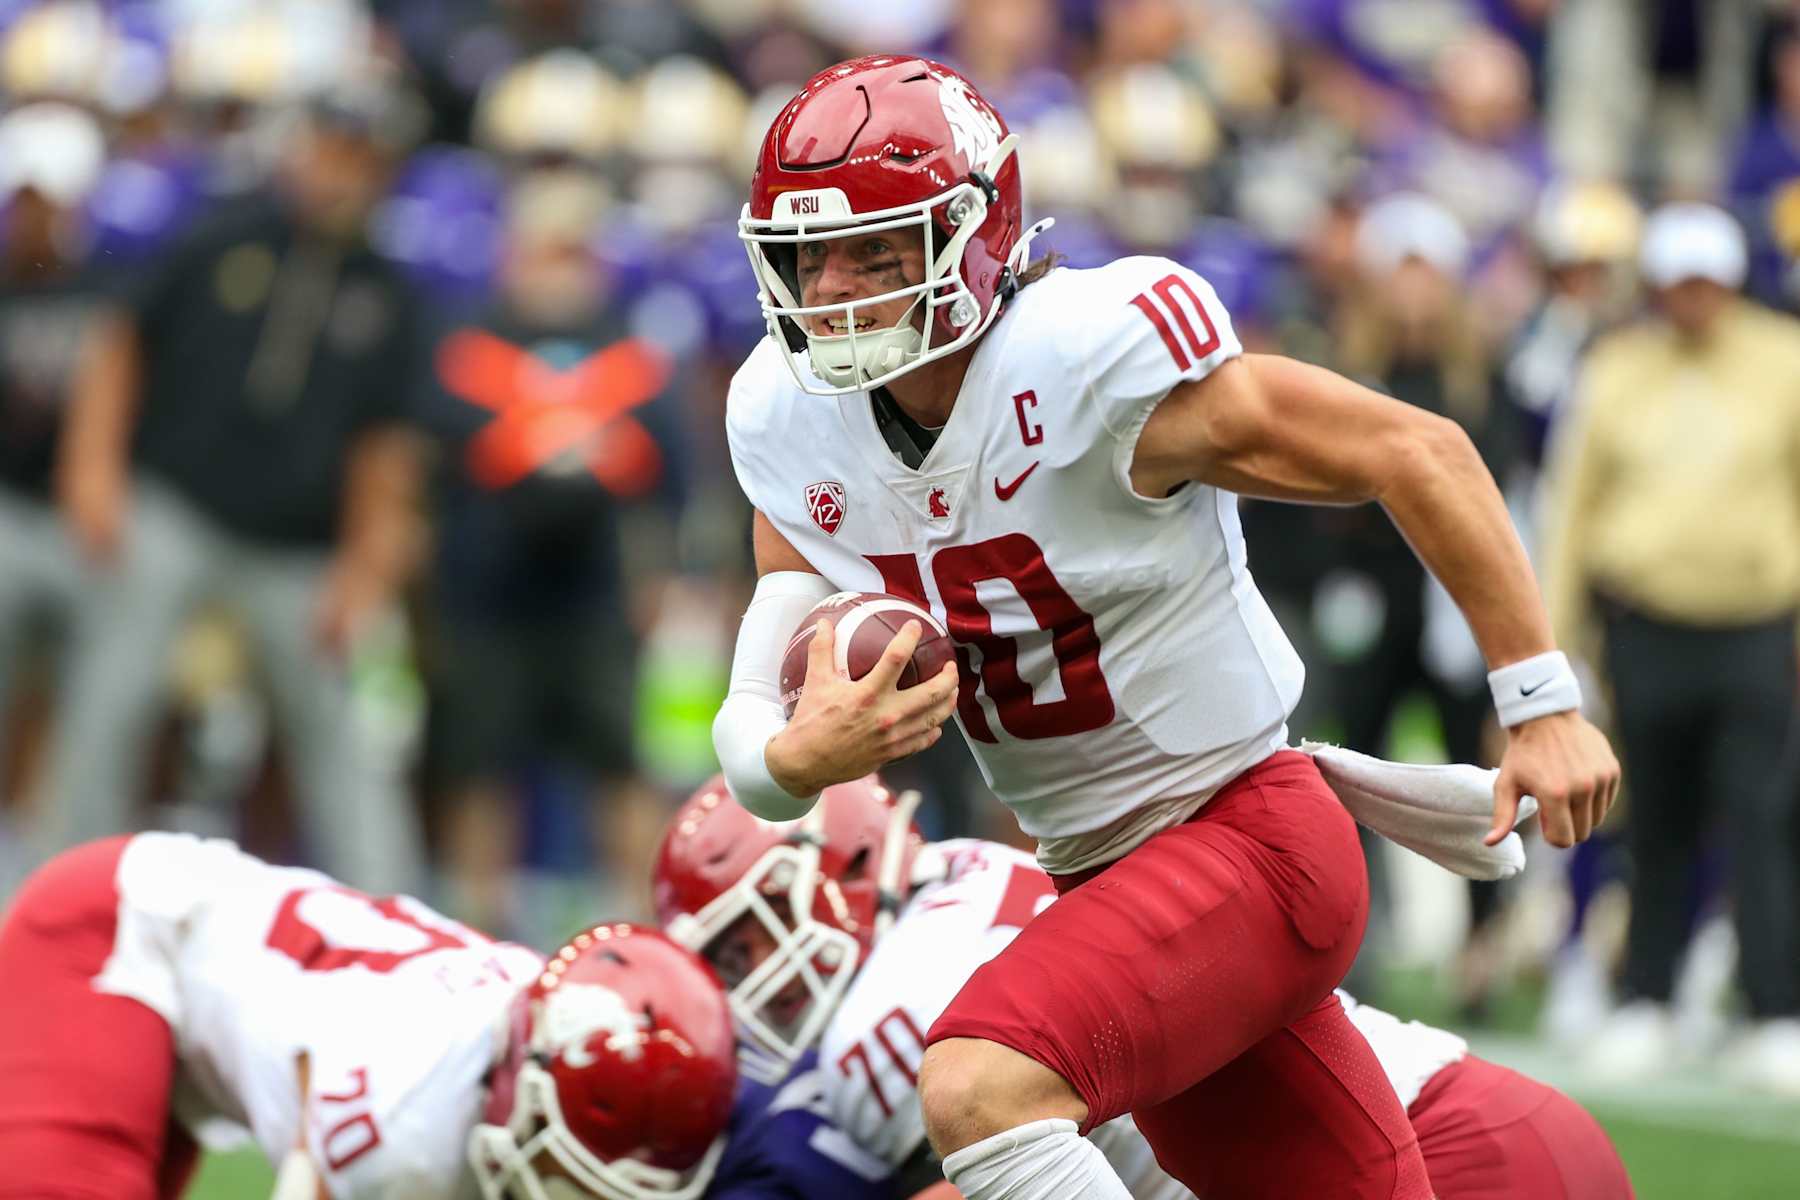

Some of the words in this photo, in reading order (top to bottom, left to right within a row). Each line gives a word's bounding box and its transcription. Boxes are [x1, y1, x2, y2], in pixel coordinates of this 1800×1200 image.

[790, 196, 819, 215] WSU
[1128, 273, 1221, 373] 10
[1011, 389, 1043, 447] C
[806, 483, 843, 515] PAC
[817, 504, 839, 525] 12
[861, 532, 1115, 744] 10
[837, 1007, 926, 1119] 70
